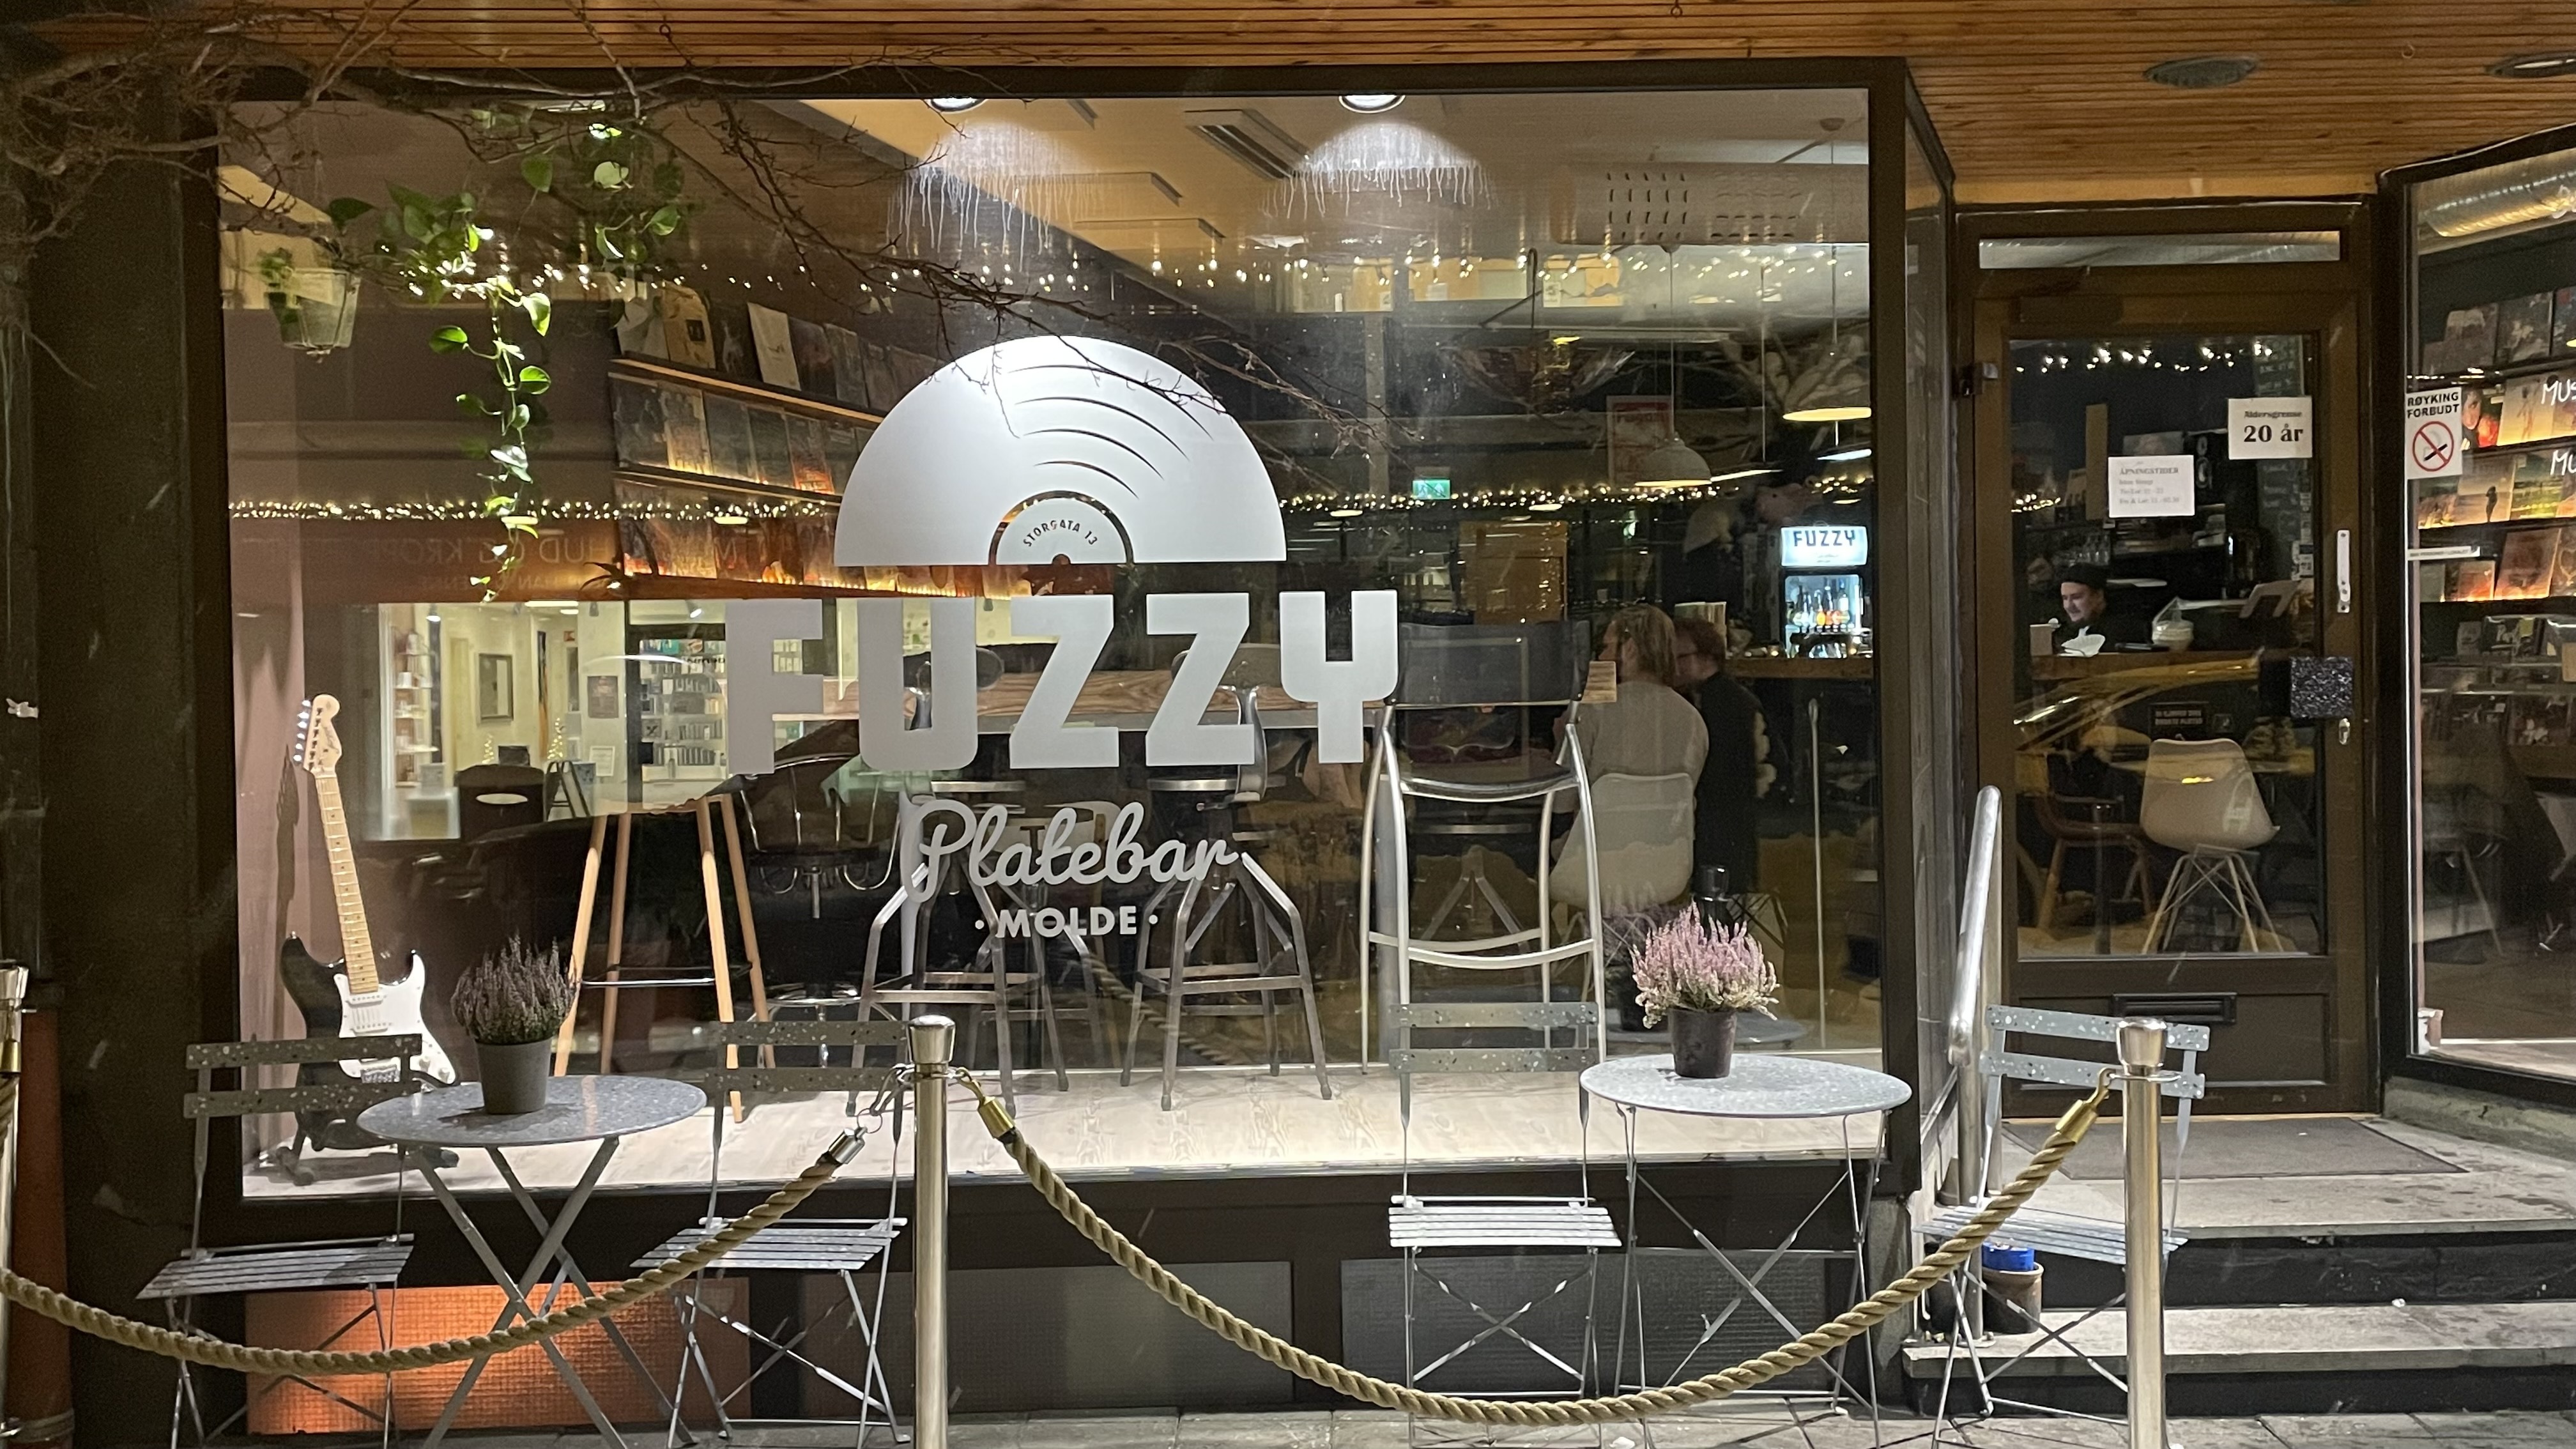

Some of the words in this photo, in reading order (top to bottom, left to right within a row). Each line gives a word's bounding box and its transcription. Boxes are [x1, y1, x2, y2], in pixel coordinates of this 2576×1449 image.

[2407, 392, 2458, 406] RØYKING
[2407, 404, 2460, 418] FORBUDT
[2244, 425, 2273, 443] 20
[2280, 424, 2304, 441] år
[1023, 519, 1080, 546] STORGATA
[1084, 530, 1098, 546] 13
[1793, 530, 1856, 547] FUZZY
[724, 589, 1399, 775] FUZZY
[900, 798, 1239, 903] Platebar
[995, 905, 1137, 939] MOLDE
